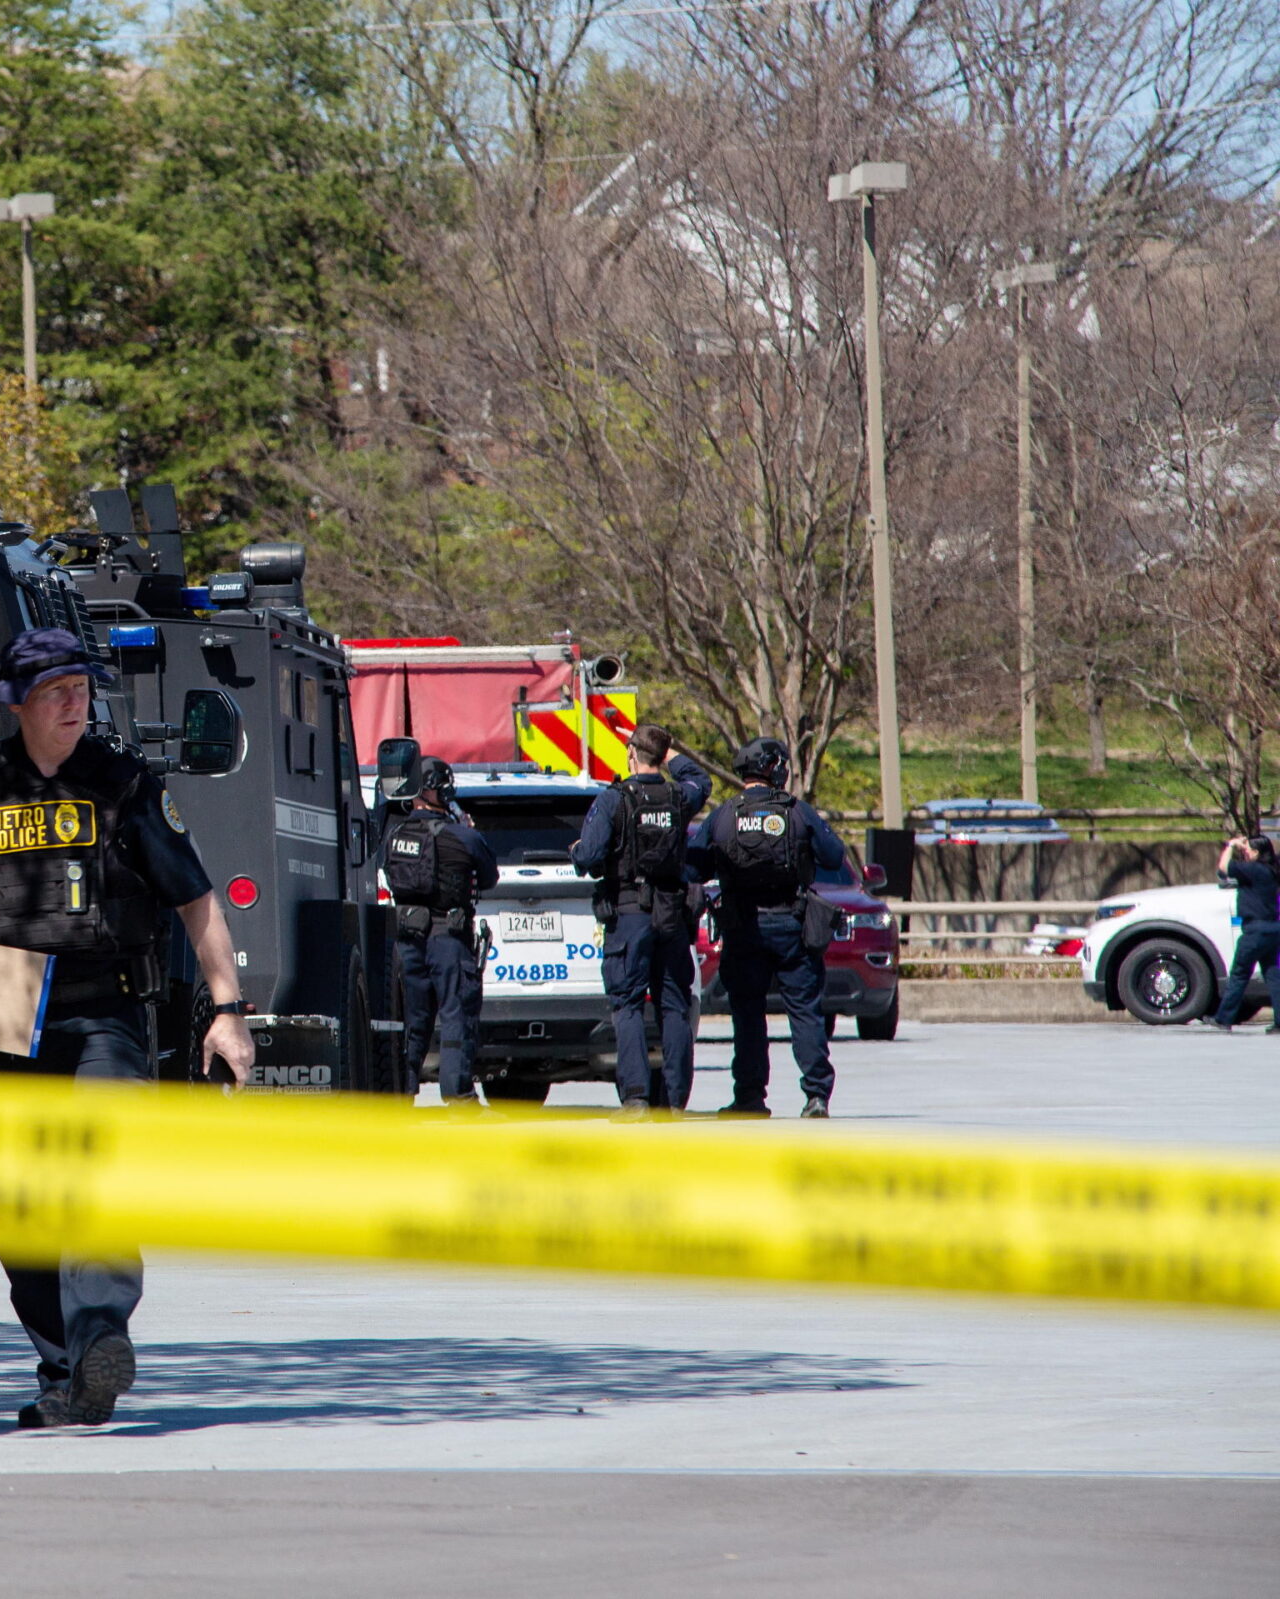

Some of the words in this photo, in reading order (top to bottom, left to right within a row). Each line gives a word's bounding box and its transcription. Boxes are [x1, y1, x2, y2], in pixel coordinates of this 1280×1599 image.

[213, 583, 242, 591] GOLIGHT
[738, 817, 762, 832] POLICE
[508, 916, 555, 931] 1247-GH
[494, 964, 569, 981] 9168BB
[246, 1064, 332, 1086] ENCO
